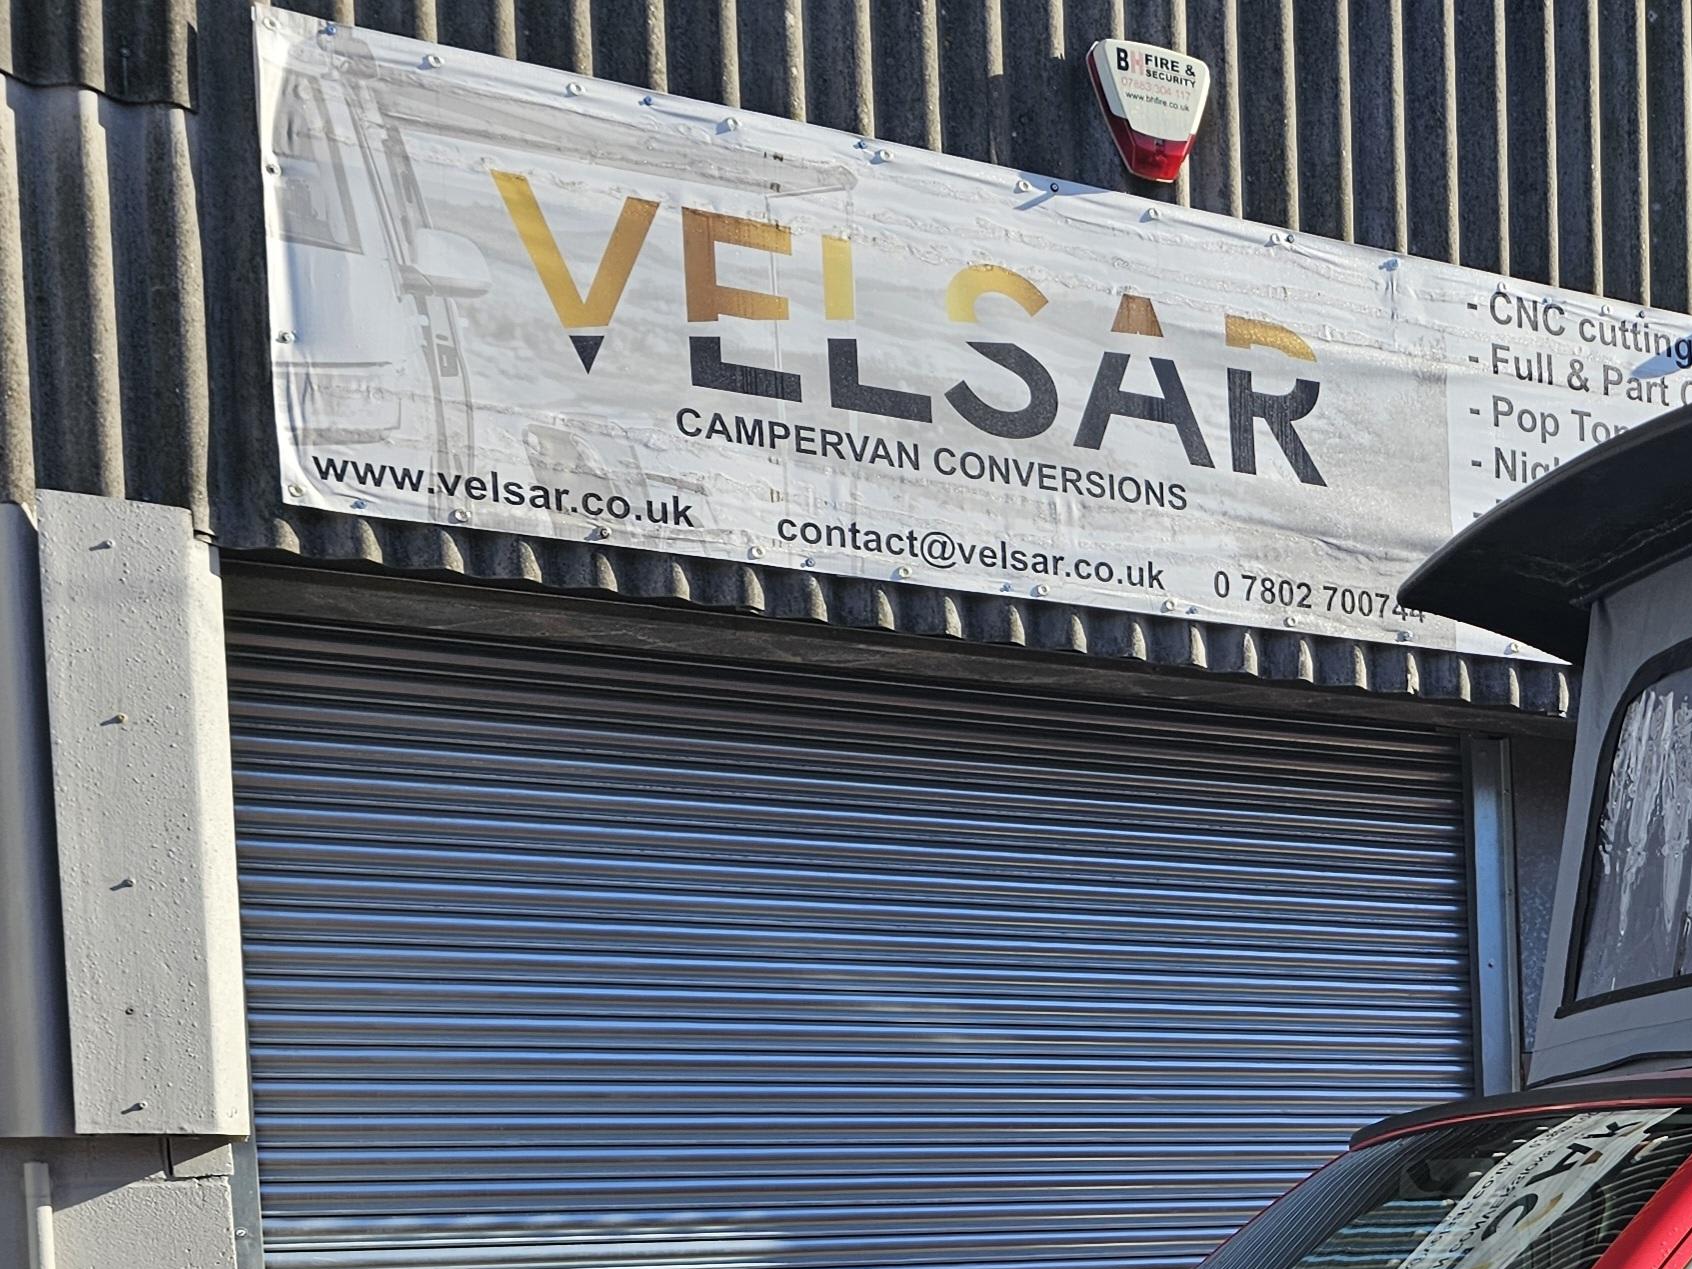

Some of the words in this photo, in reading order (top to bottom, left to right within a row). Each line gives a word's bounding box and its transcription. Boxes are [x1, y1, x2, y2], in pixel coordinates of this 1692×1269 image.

[1144, 53, 1180, 73] FIRE
[1185, 64, 1196, 77] &
[1145, 69, 1196, 88] SECURITY
[489, 169, 1329, 488] VELSAR
[1489, 291, 1566, 336] CNC
[1491, 342, 1554, 386] Full
[1566, 358, 1590, 393] &
[1602, 363, 1670, 407] Part
[1492, 394, 1560, 444] Pop
[676, 406, 920, 471] CAMPERVAN
[933, 446, 1187, 512] CONVERSIONS
[311, 455, 695, 529] www.velsar.co.uk
[776, 517, 1165, 591] contact@velsar.co.uk
[1213, 570, 1230, 598] 0
[1241, 574, 1313, 609] 7802
